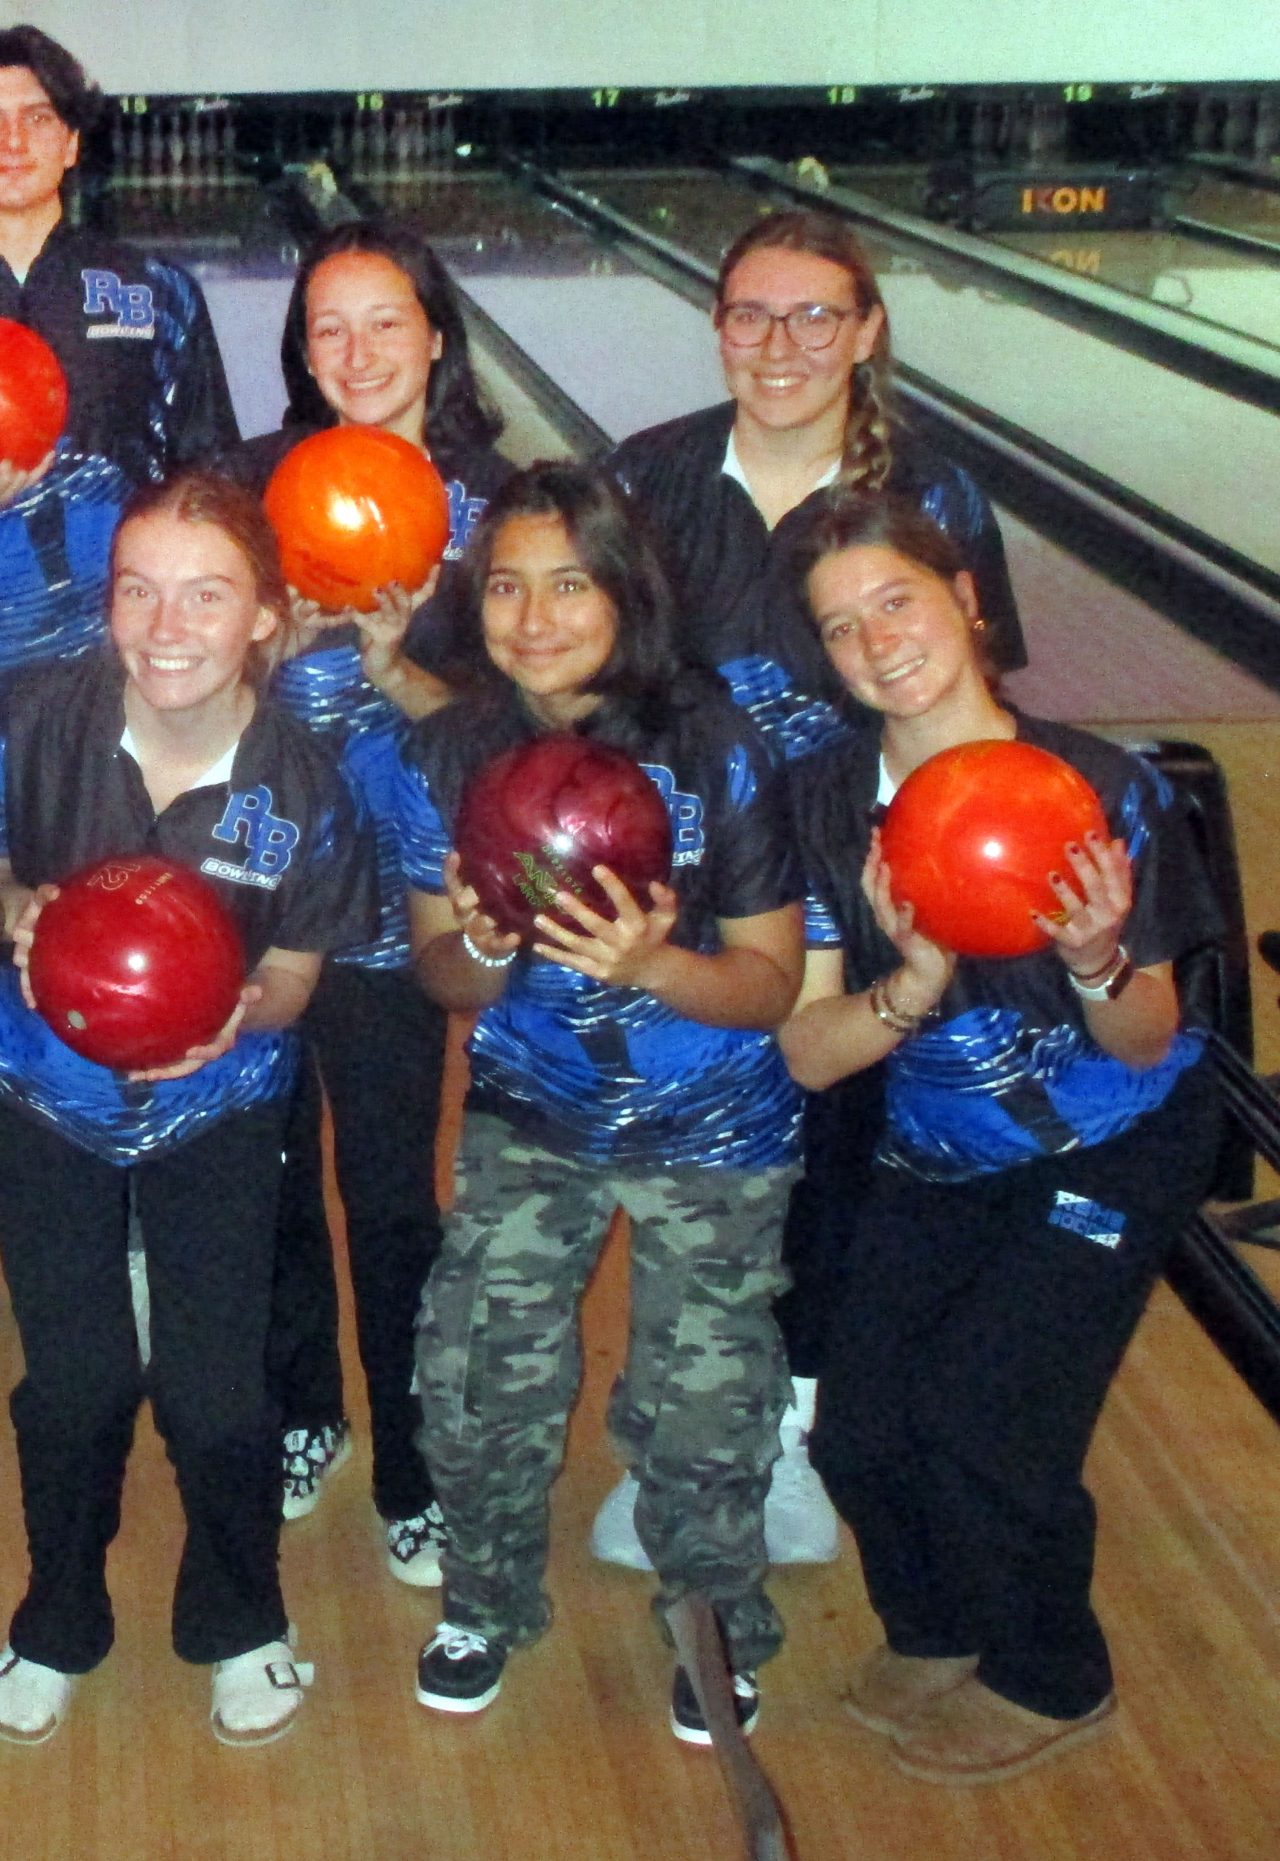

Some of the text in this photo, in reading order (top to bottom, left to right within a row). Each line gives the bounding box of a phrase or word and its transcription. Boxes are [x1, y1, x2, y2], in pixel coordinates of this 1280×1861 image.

[592, 89, 619, 107] 17
[1022, 187, 1106, 213] IKON
[81, 270, 154, 328] RB
[212, 784, 300, 876] RB
[200, 857, 282, 891] BOWLING
